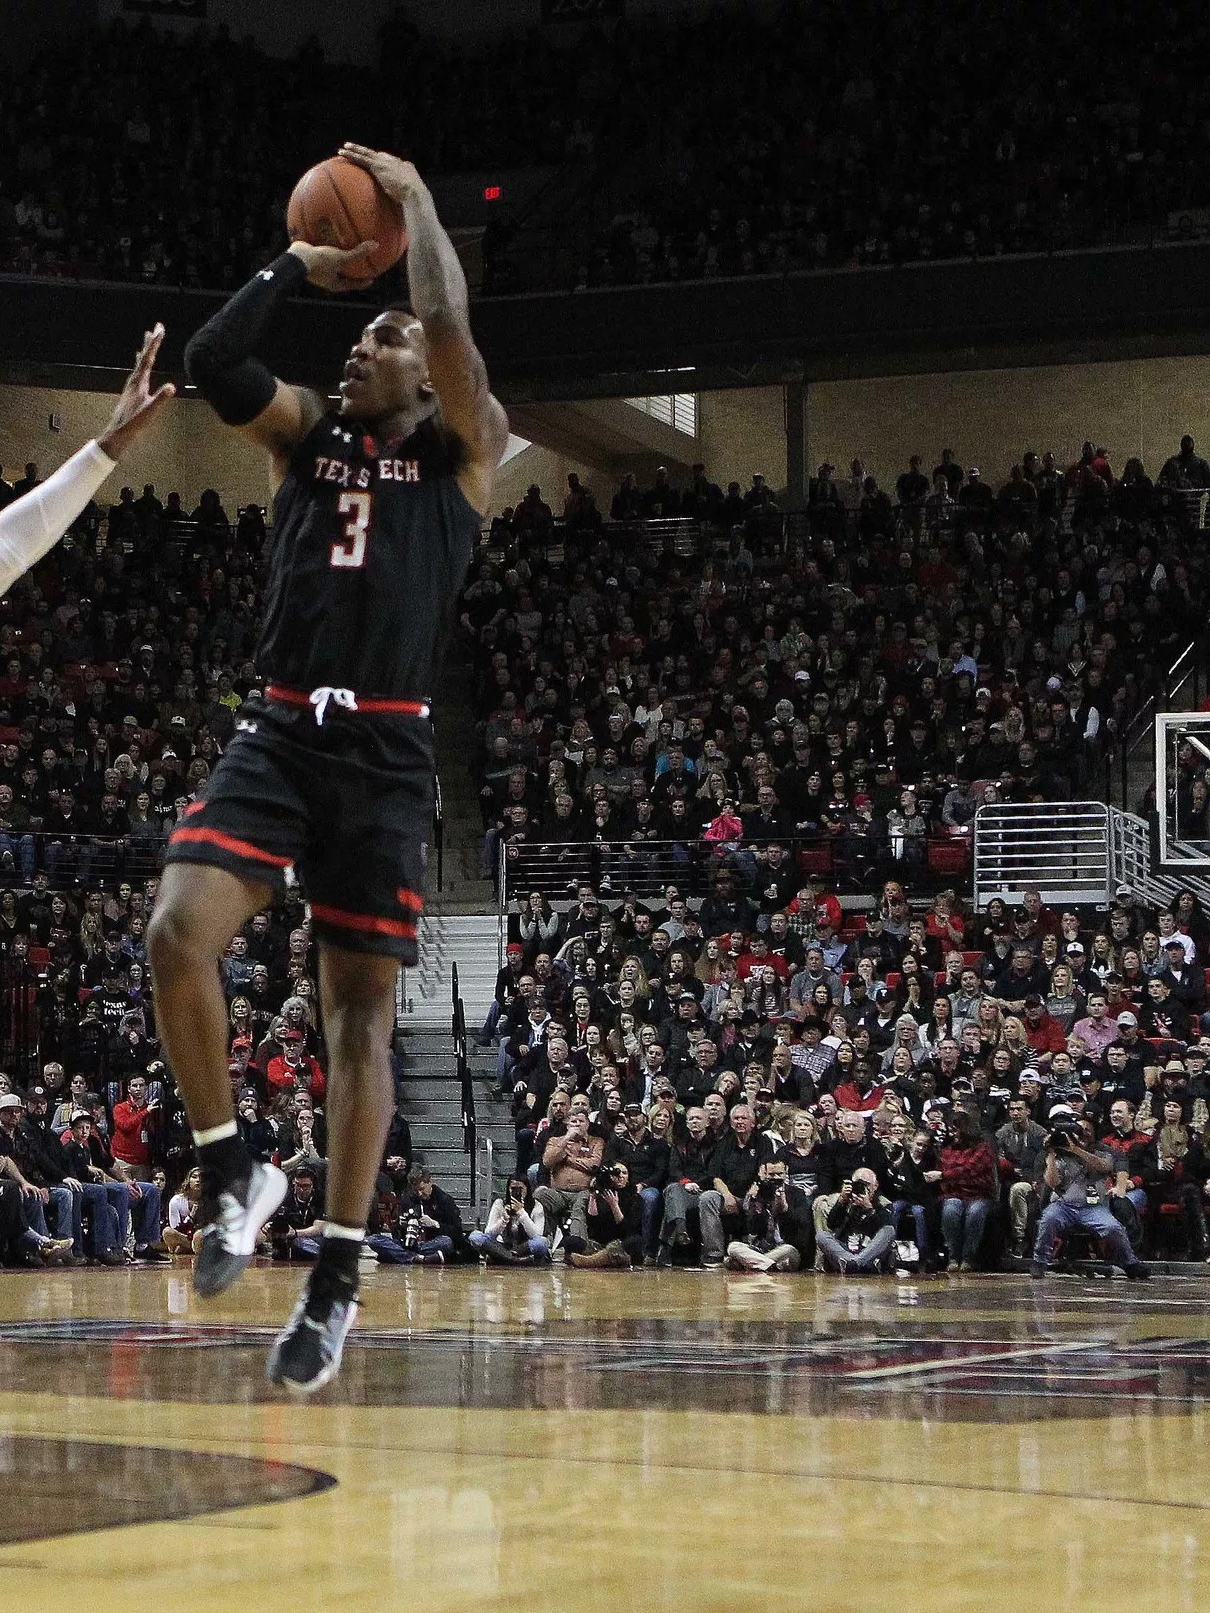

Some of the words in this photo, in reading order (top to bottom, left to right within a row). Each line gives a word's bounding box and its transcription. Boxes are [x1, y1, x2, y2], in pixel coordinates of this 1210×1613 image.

[315, 456, 371, 488] TEXS
[378, 458, 421, 483] ECH
[330, 490, 373, 568] 3
